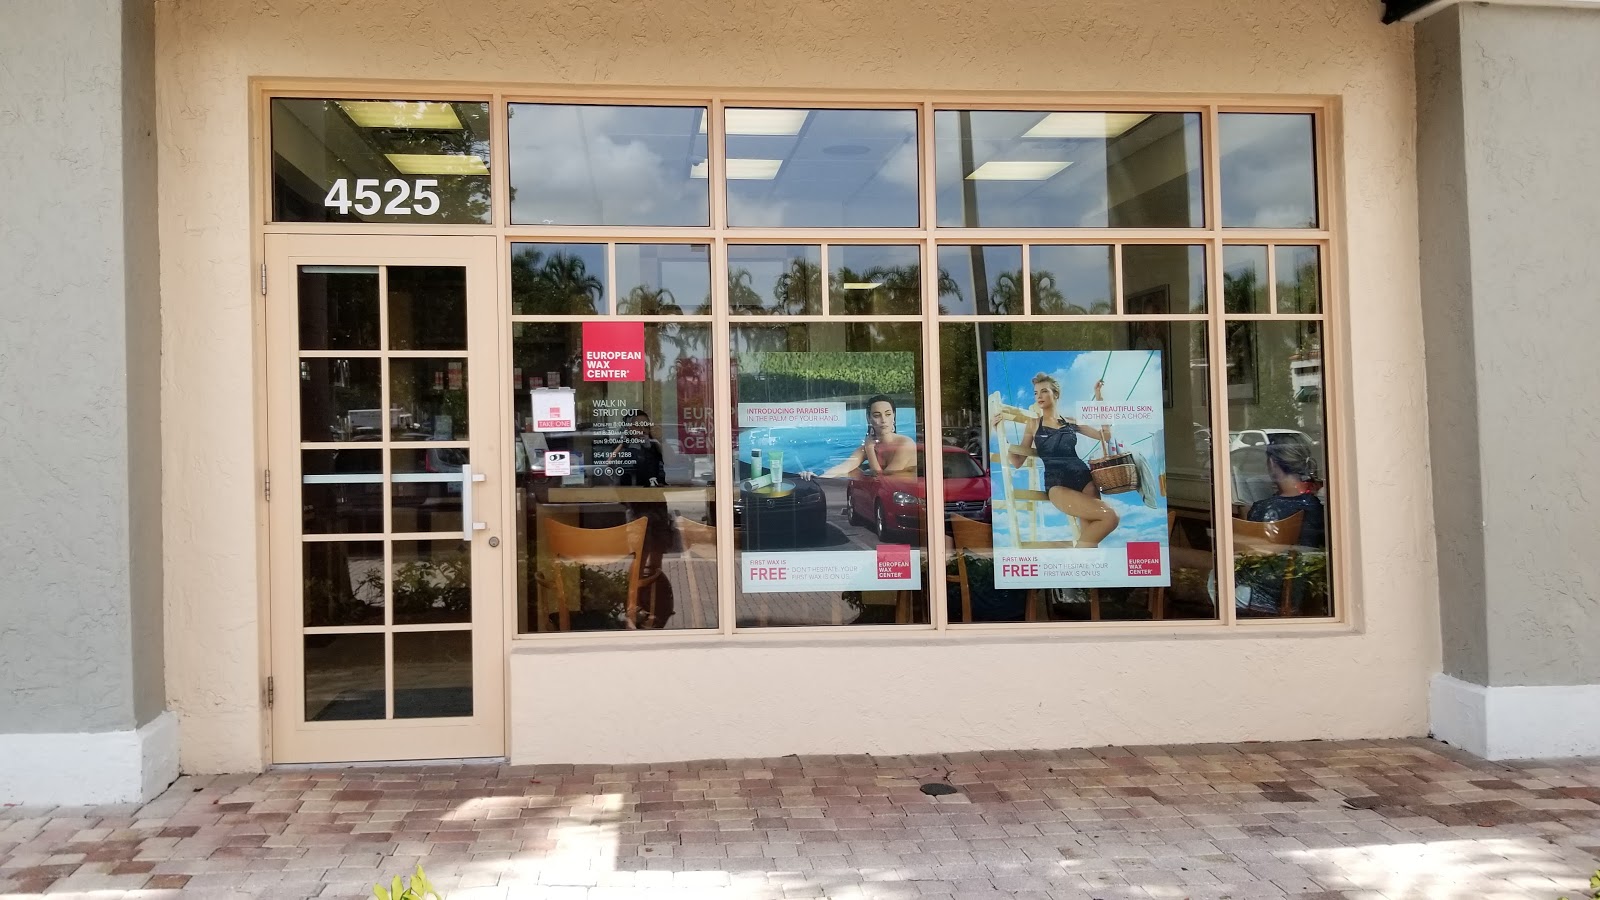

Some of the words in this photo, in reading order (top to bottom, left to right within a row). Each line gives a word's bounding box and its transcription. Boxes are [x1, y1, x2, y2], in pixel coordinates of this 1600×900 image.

[324, 178, 440, 215] 4525
[586, 351, 641, 360] EUROPEAN
[586, 360, 610, 369] WAX
[592, 399, 616, 407] WALK
[617, 399, 627, 407] IN
[592, 408, 619, 417] STRUT
[620, 408, 639, 417] OUT
[555, 420, 571, 428] ONE
[593, 451, 604, 459] 954
[605, 451, 616, 459] 915
